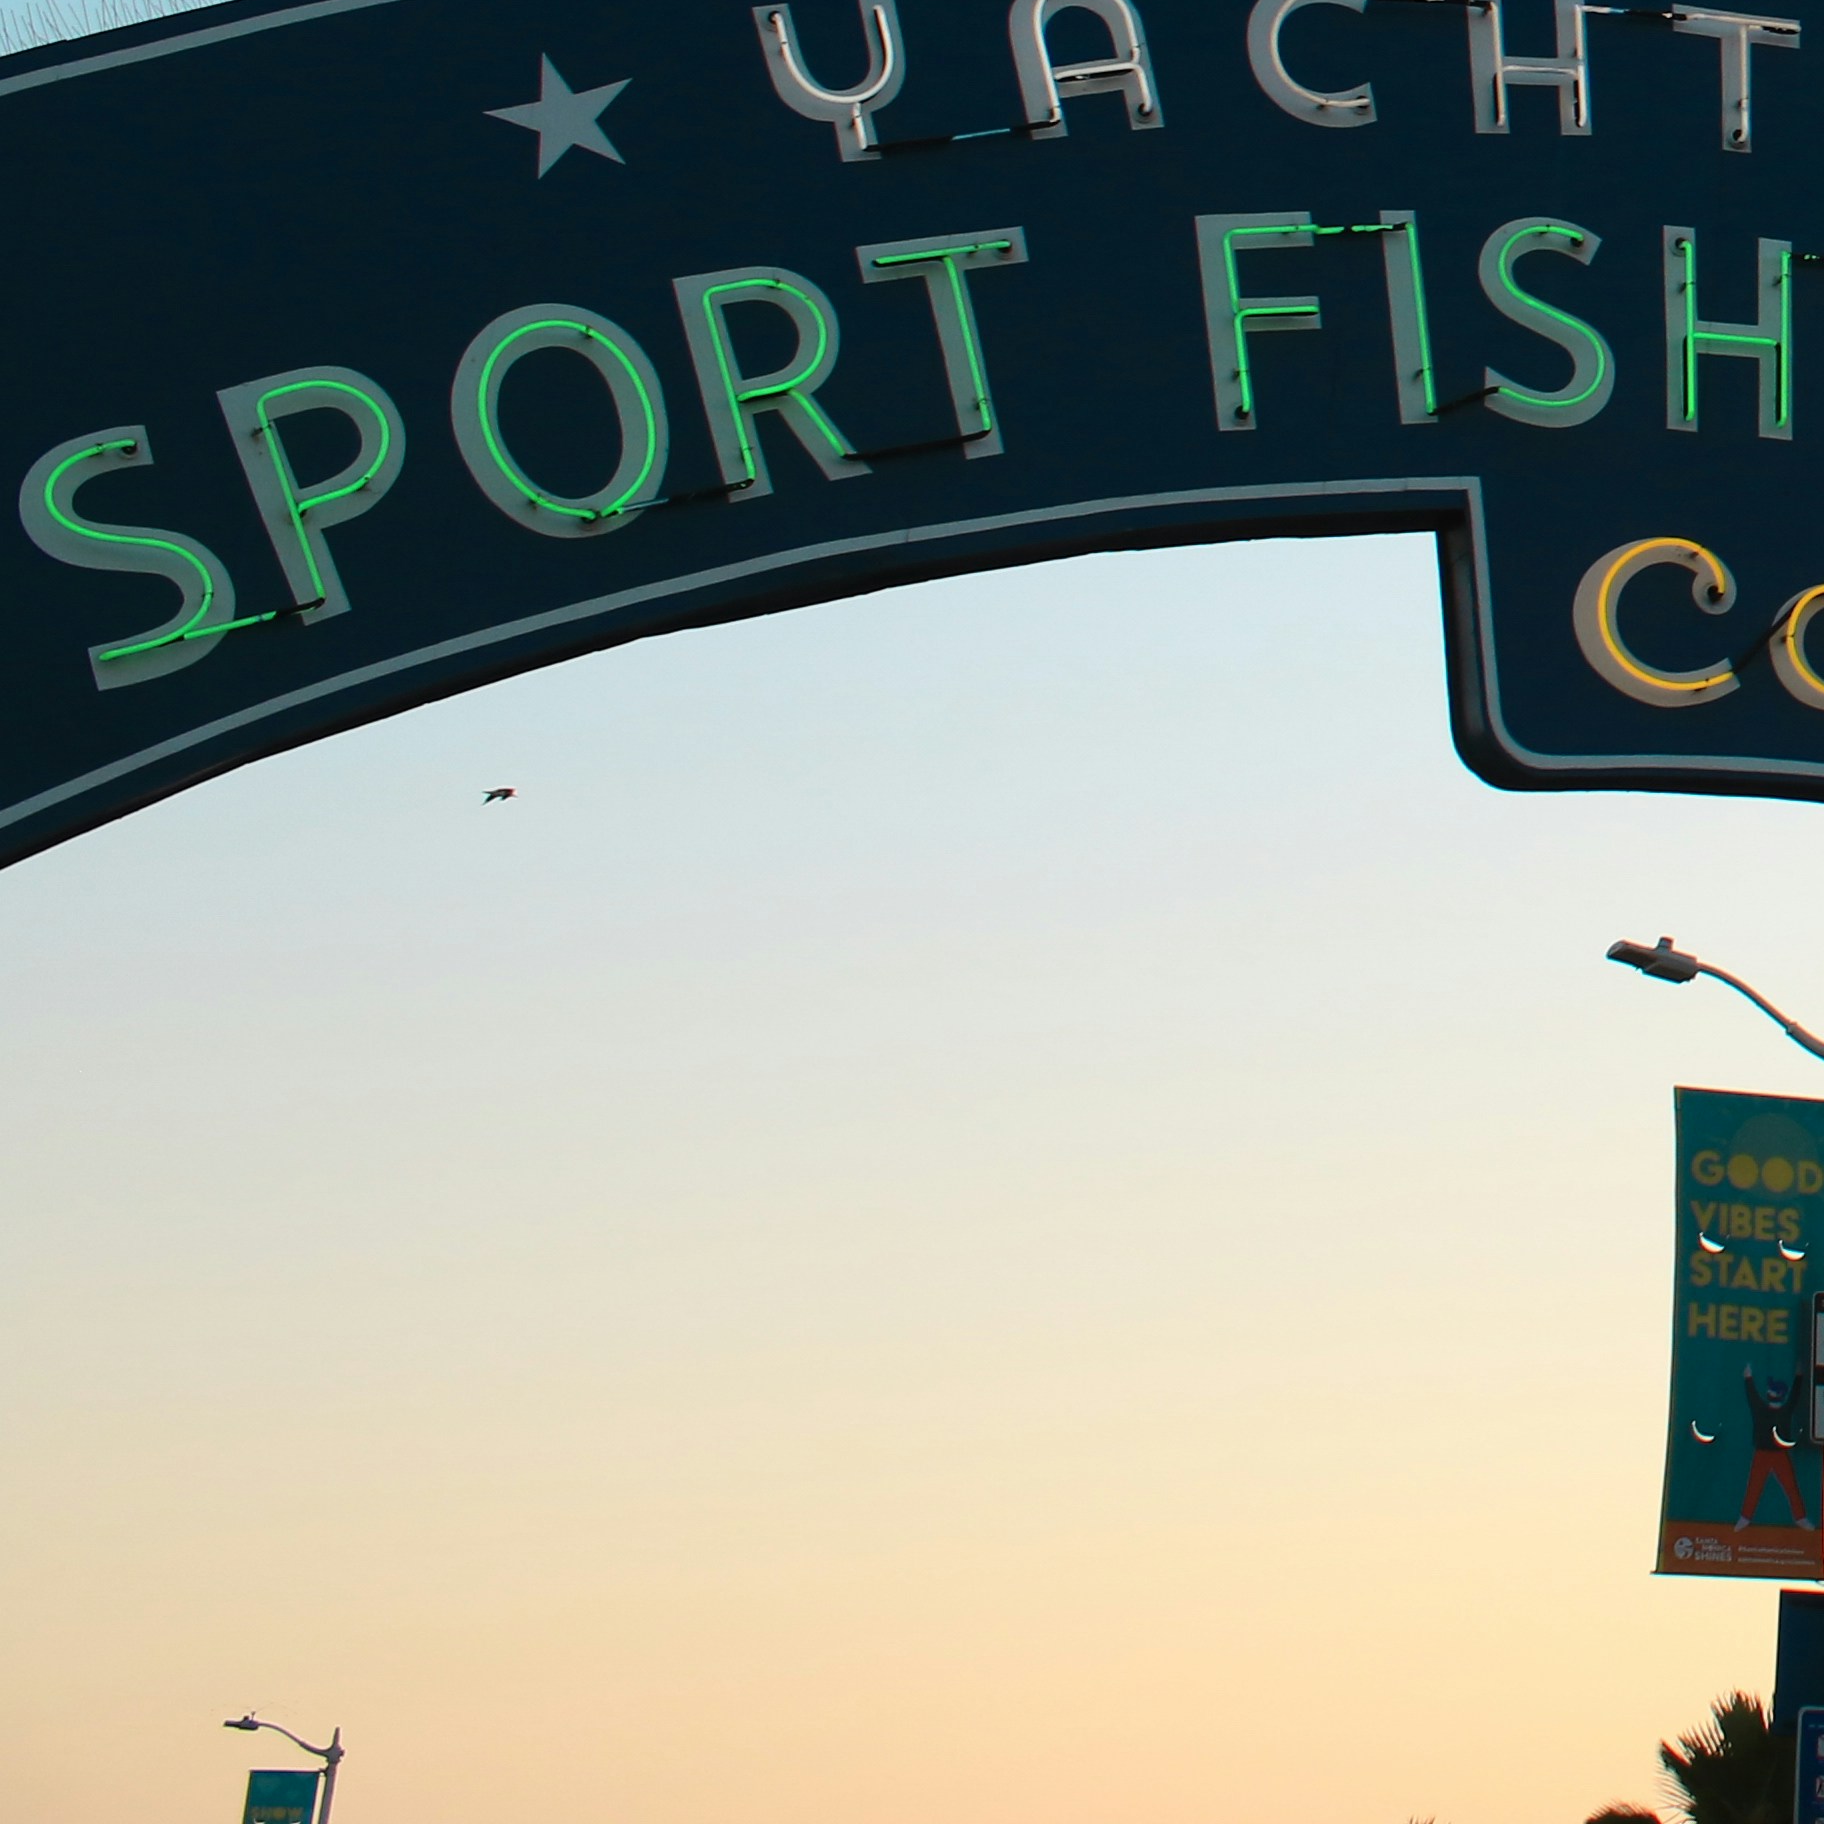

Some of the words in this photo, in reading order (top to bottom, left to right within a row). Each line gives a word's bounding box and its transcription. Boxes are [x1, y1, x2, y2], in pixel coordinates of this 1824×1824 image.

[18, 226, 1029, 690] SPORT
[1691, 1149, 1824, 1194] GOOD
[1690, 1200, 1802, 1242] VIBES
[1690, 1249, 1808, 1294] START
[1687, 1302, 1789, 1344] HERE
[1694, 1551, 1733, 1562] SHINES
